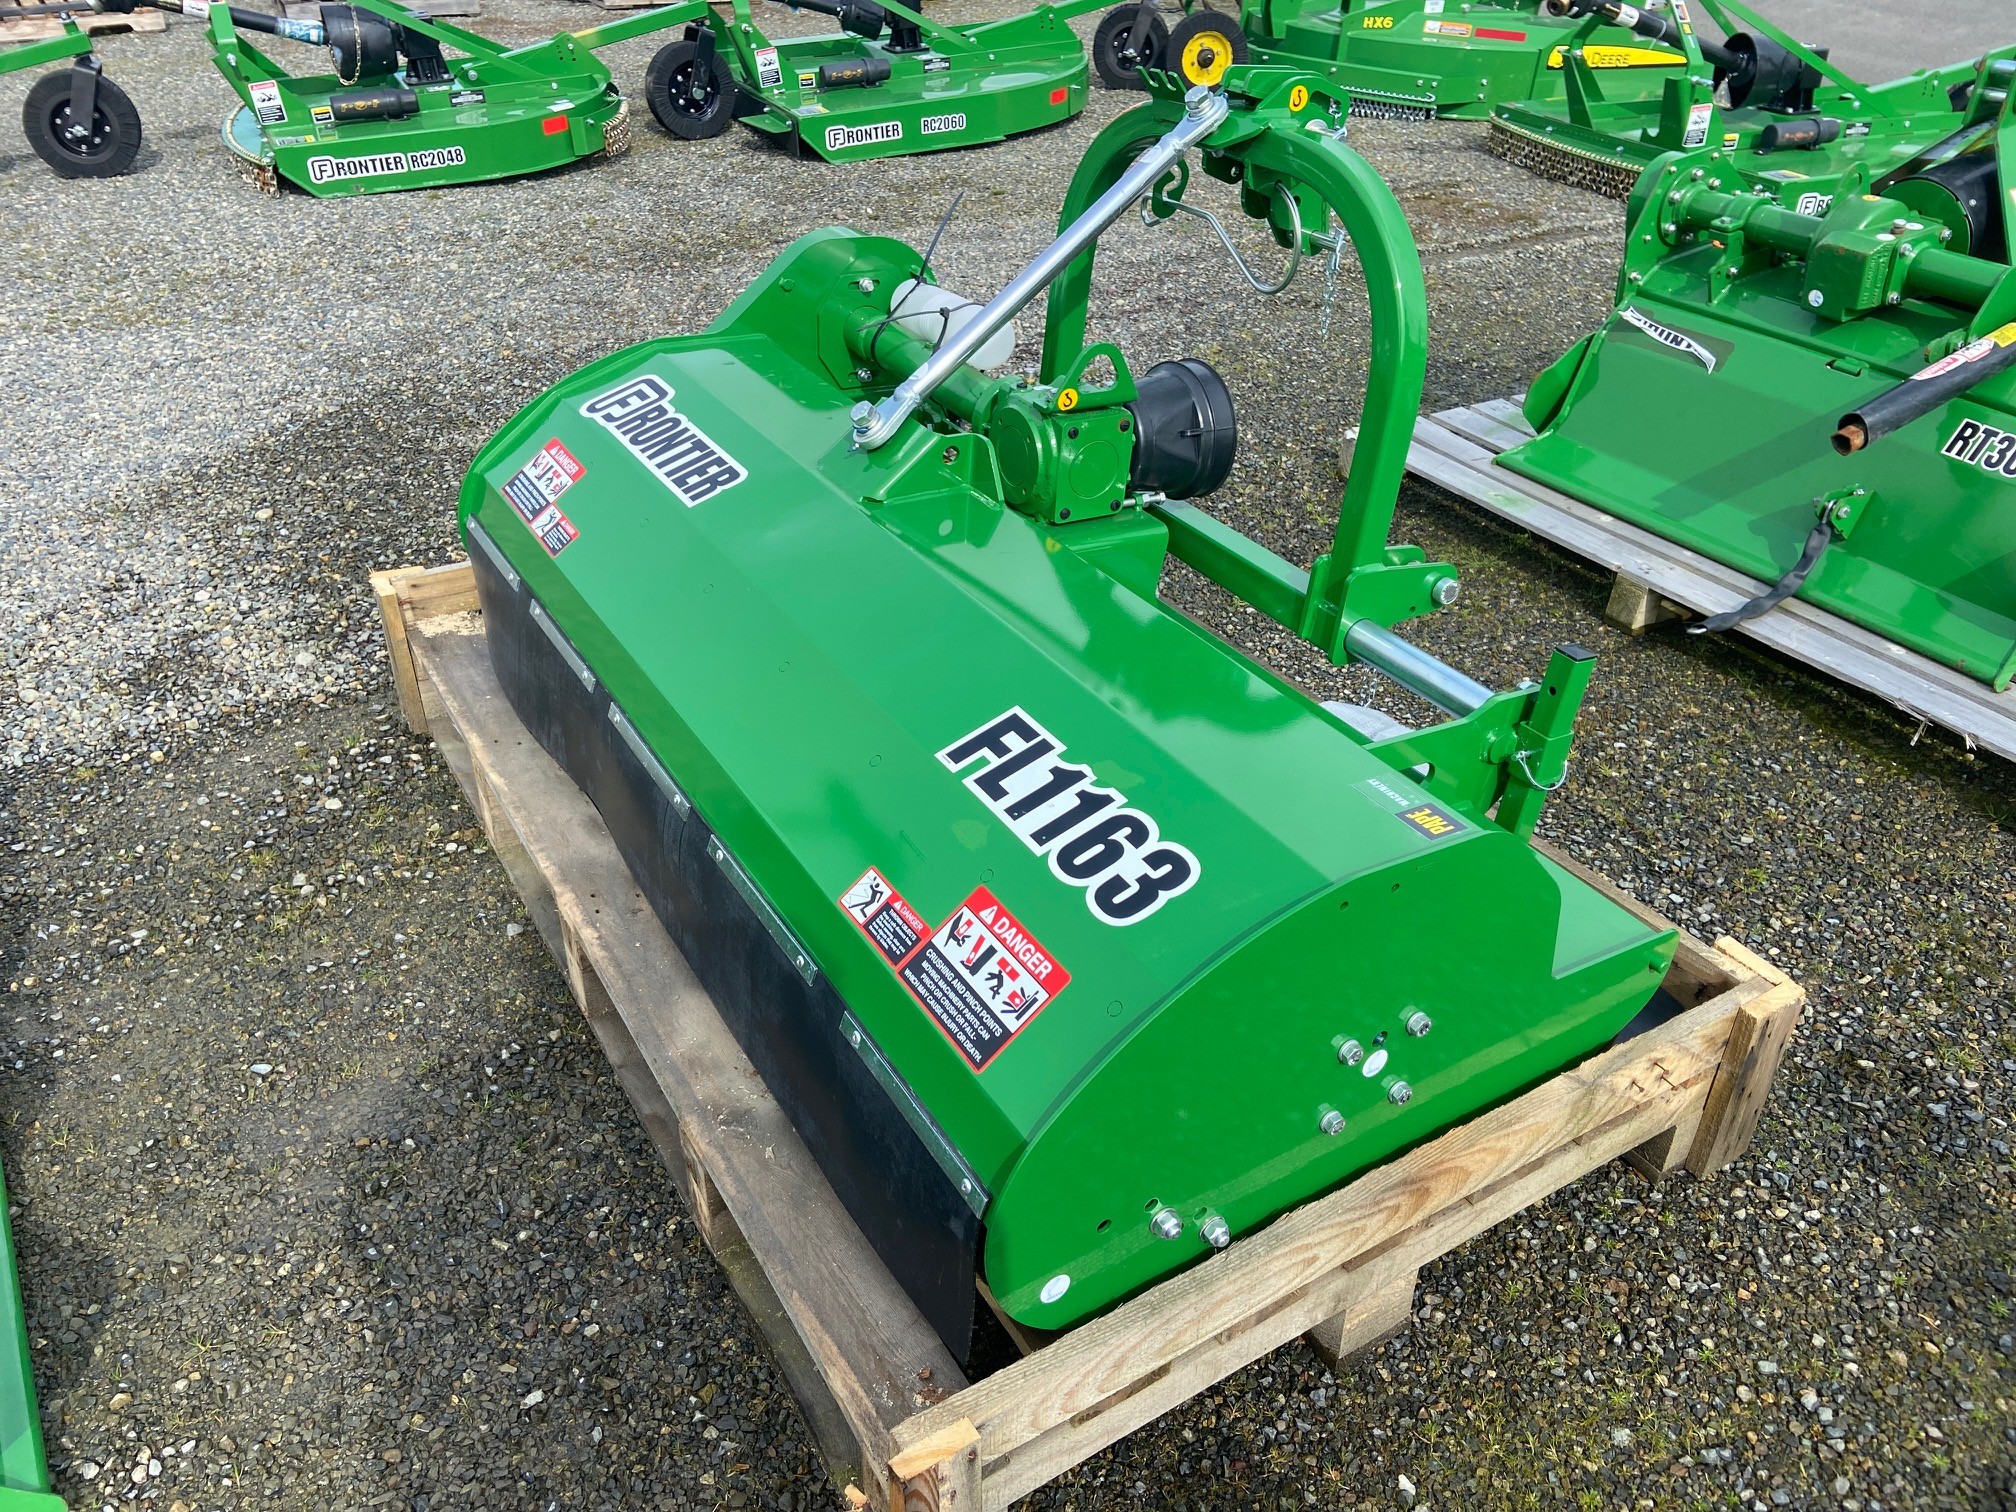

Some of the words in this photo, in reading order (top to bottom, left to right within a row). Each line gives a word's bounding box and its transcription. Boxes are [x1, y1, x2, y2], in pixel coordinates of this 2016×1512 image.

[1363, 16, 1394, 29] HX6
[1591, 52, 1631, 65] DEERE
[829, 123, 900, 148] FRONTIER
[923, 115, 964, 132] RC2060
[312, 156, 404, 181] FRONTIER
[411, 148, 464, 169] RC2048
[585, 377, 741, 502] FRONTIER
[554, 449, 579, 475] DANGER
[1366, 778, 1411, 807] MACHINERY
[946, 713, 1192, 919] FL1163
[899, 905, 925, 932] DANGER
[991, 915, 1054, 980] DANGER
[921, 959, 941, 982] MOVING
[937, 978, 965, 1011] MACHINERY
[961, 1007, 980, 1029] PARTS
[976, 1025, 990, 1041] CAN
[925, 947, 955, 981] CRUSHING
[950, 977, 966, 995] AND
[962, 990, 983, 1014] PINCH
[978, 1009, 1003, 1037] POINTS
[903, 967, 920, 987] WHICH
[917, 984, 929, 999] MAY
[926, 995, 944, 1016] CAUSE
[940, 1012, 959, 1034] INJURY
[955, 1031, 966, 1043] OR
[962, 1039, 982, 1063] DEATH.
[920, 972, 936, 991] PINCH
[932, 987, 943, 999] OR
[939, 995, 958, 1017] CRUSH
[954, 1013, 965, 1025] OR
[961, 1021, 978, 1041] FALL-
